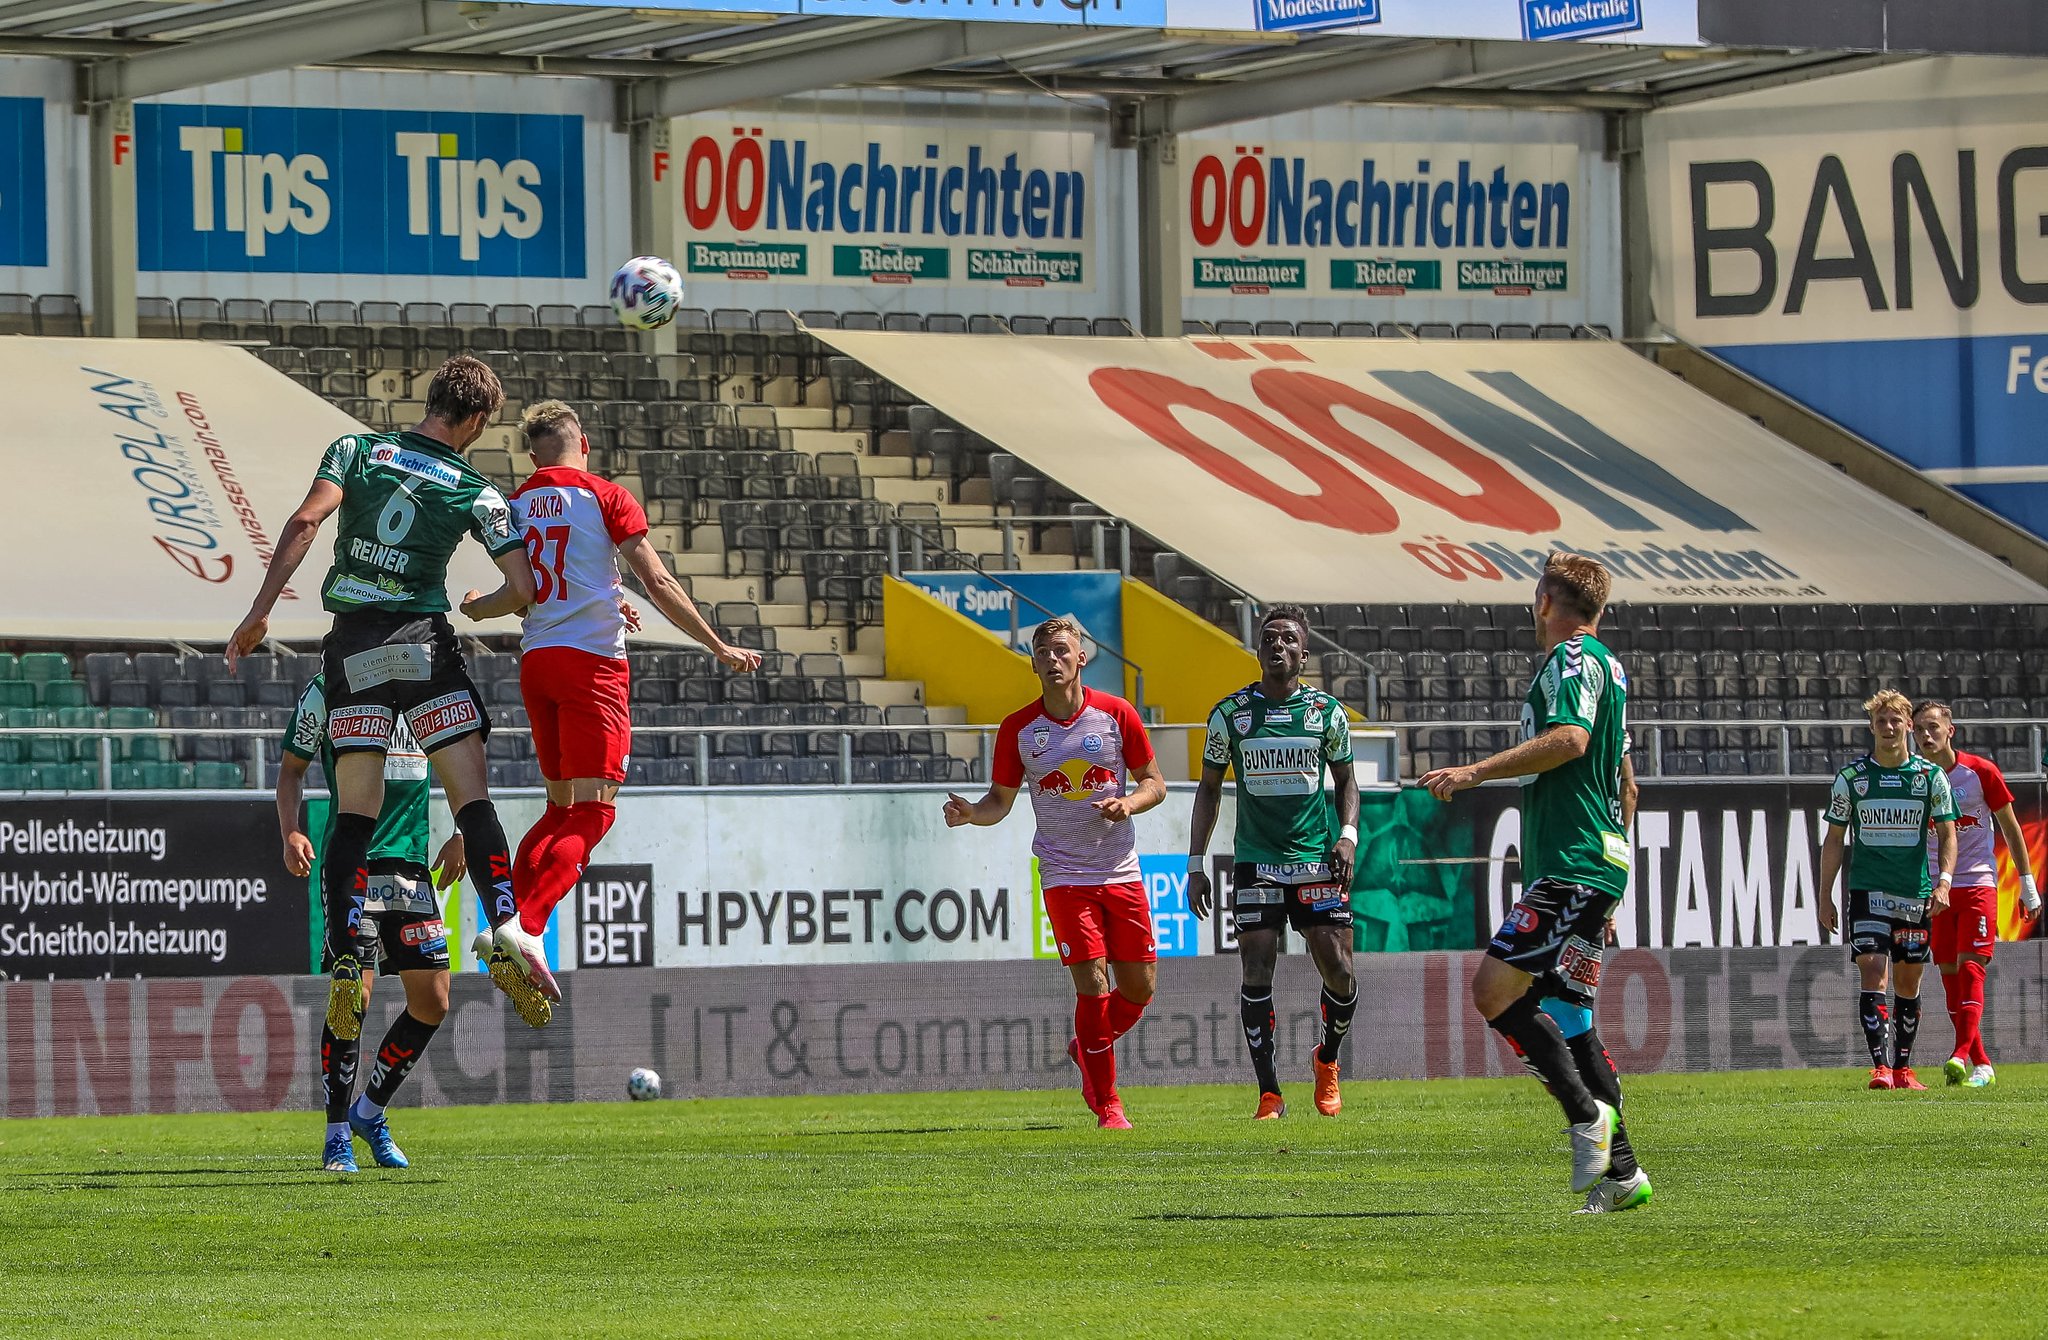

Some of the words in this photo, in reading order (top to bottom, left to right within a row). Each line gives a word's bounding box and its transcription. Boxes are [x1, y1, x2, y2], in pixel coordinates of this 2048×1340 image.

[114, 134, 131, 165] F
[654, 152, 670, 182] F
[179, 126, 330, 257] Tips
[395, 132, 543, 261] Tips
[684, 128, 1086, 239] OÖNachrichten
[1190, 146, 1571, 249] OÖNachrichten
[693, 245, 801, 270] Braunauer
[859, 247, 924, 273] Rieder
[969, 250, 1080, 282] Schärdinger
[1199, 261, 1300, 284] Braunauer
[1355, 261, 1417, 285] Rieder
[1460, 260, 1565, 291] Schärdinger
[381, 378, 396, 394] 10
[731, 384, 746, 399] 10
[856, 438, 864, 452] 9
[1089, 339, 1761, 535] OÖN
[377, 447, 457, 485] OÖNachrichten
[528, 495, 563, 519] BUKTA
[937, 487, 945, 501] 8
[377, 474, 424, 546] 6
[350, 537, 411, 575] REINER
[665, 534, 673, 549] 7
[523, 524, 571, 605] 37
[747, 585, 756, 601] 6
[830, 636, 839, 651] 5
[362, 653, 400, 668] elements
[333, 707, 357, 718] FLIESEN
[409, 702, 432, 719] FLIESEN
[439, 694, 458, 706] STEIN
[1860, 808, 1921, 825] GUNTAMATIC
[0, 819, 166, 861] Pelletheizung
[0, 870, 268, 913] Hybrid-Wärmepumpe
[367, 884, 432, 903] IRO-POOL
[583, 880, 649, 922] HPY
[1301, 886, 1339, 901] FUSS
[678, 888, 1010, 946] HPYBET.COM
[1152, 913, 1190, 950] ET
[0, 921, 227, 962] Scheitholzheizung
[404, 923, 444, 942] FUSS
[583, 923, 649, 965] BET
[695, 1005, 748, 1080] IT
[767, 1000, 813, 1079] &
